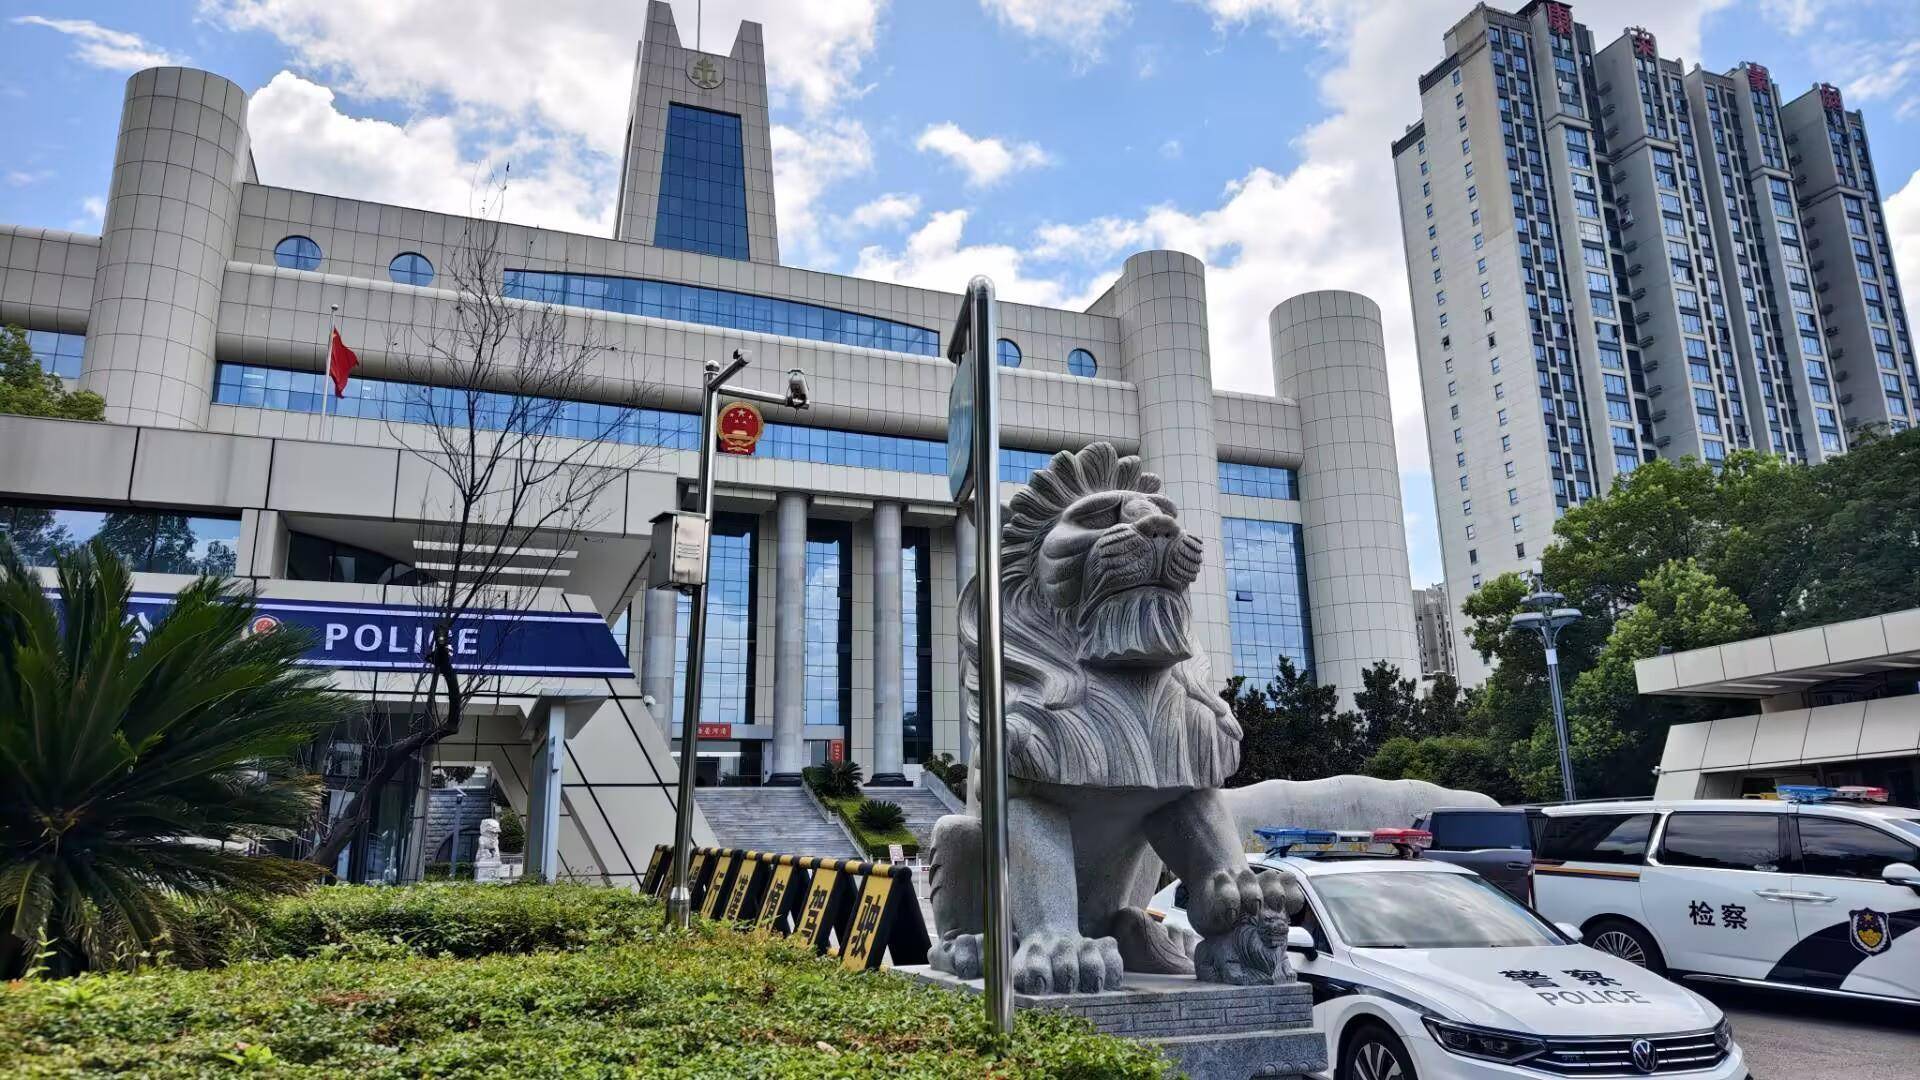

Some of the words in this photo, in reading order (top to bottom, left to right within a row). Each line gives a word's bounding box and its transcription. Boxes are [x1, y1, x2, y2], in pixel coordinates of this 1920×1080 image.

[1688, 900, 1749, 930] 检察
[1498, 969, 1623, 989] 警察
[1535, 990, 1652, 1006] POLICE
